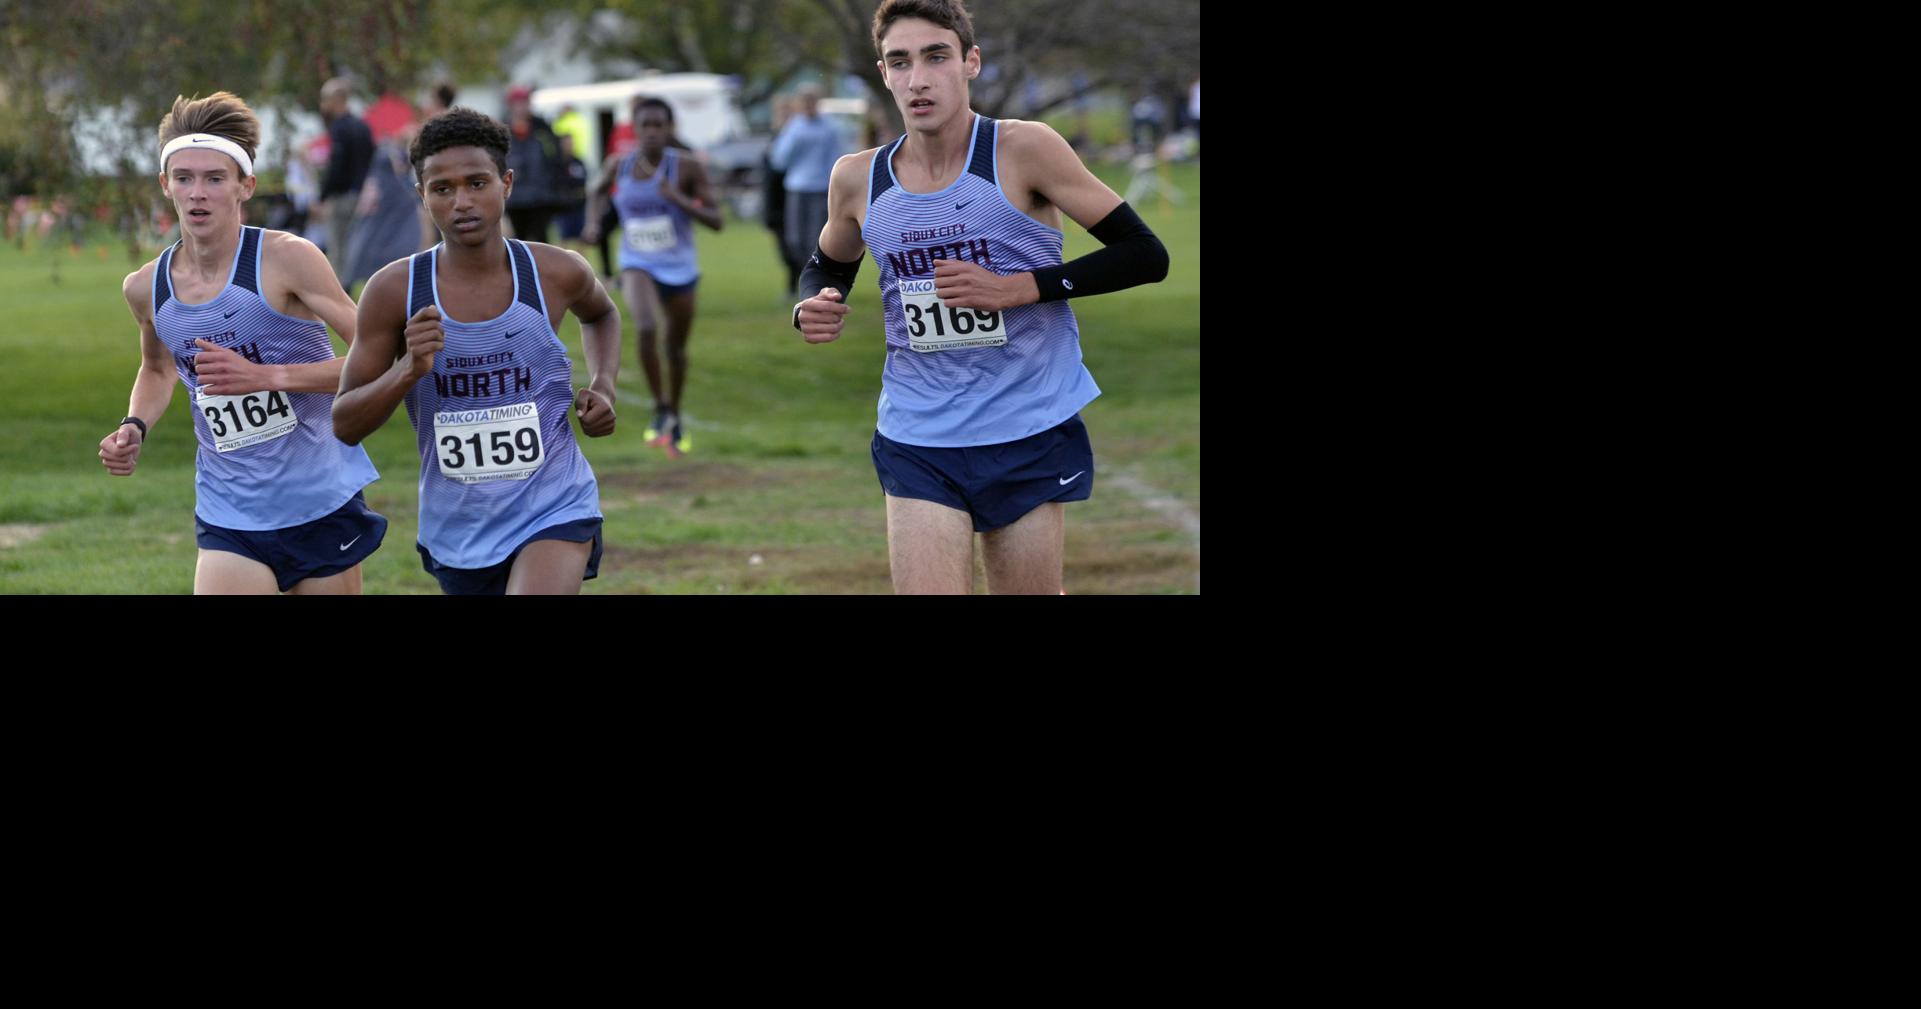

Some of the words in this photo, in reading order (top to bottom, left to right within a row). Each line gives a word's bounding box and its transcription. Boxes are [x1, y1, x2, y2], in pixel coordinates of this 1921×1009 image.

[901, 228, 936, 243] SIOUX
[939, 223, 966, 237] CITY
[886, 238, 992, 278] NORTH
[905, 302, 999, 337] 3169
[215, 331, 236, 344] CITY
[447, 355, 486, 369] SIOUX
[487, 351, 514, 365] CITY
[434, 367, 531, 398] NORTH
[205, 390, 289, 437] 3164
[440, 404, 531, 424] DAKOTATIMING
[440, 427, 540, 469] 3159
